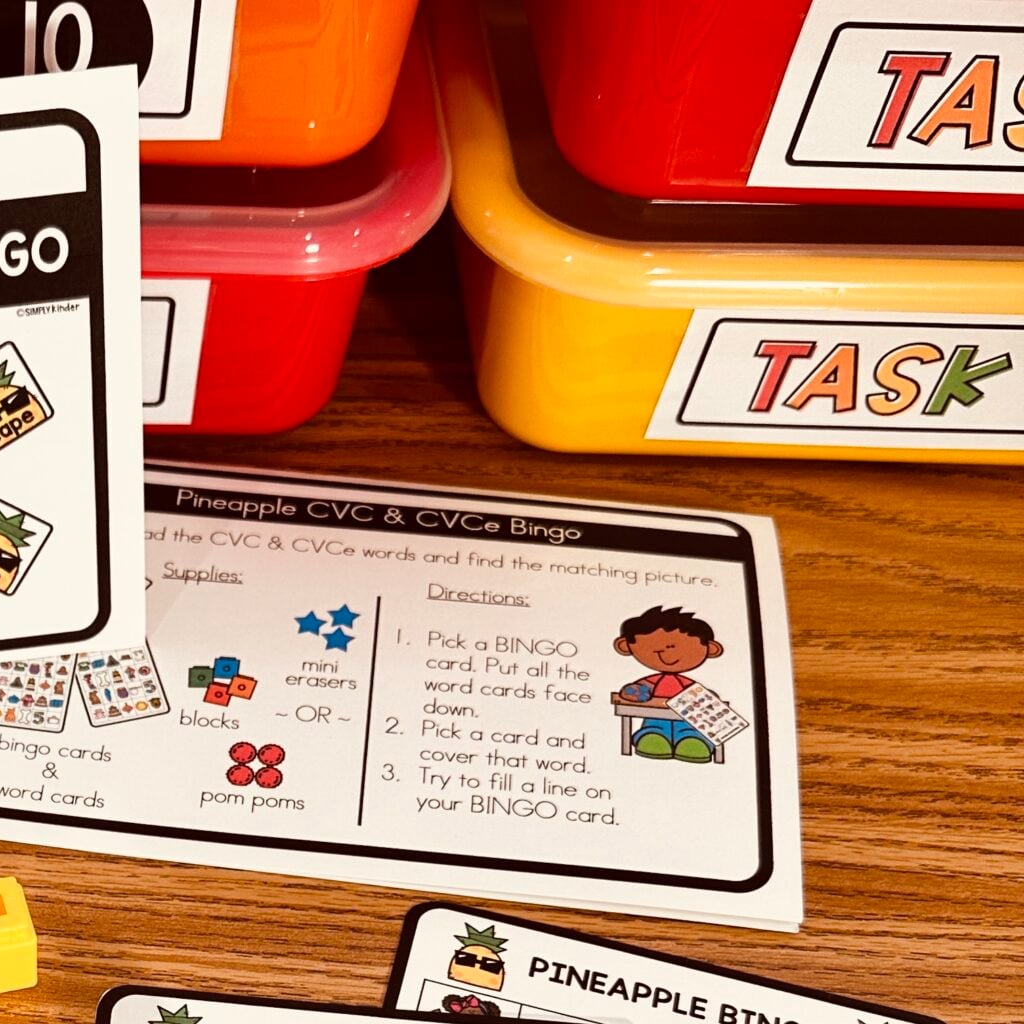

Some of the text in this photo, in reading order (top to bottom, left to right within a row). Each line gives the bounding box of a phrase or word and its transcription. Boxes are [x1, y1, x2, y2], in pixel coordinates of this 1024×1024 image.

[867, 51, 1024, 152] TA
[747, 340, 1013, 417] TASK
[176, 488, 581, 544] Pineapple CVC & CVCe Bingo
[144, 527, 719, 588] ad the CVC & CVCe words and find the matching picture.
[162, 562, 243, 586] Supplies:
[427, 583, 531, 607] Directions:
[397, 629, 578, 658] 1. Pick a BINGO
[302, 660, 339, 673] mini
[426, 656, 590, 681] card. Put all the
[286, 674, 357, 690] erasers
[425, 679, 591, 704] word cards face
[179, 709, 240, 730] blocks
[295, 704, 332, 723] OR
[423, 698, 479, 718] down.
[385, 716, 585, 749] 2. Pick a card and
[58, 745, 112, 762] cards
[420, 749, 591, 774] cover that word.
[41, 761, 59, 780] &
[381, 764, 611, 800] 3. Try to fill a line on
[51, 790, 105, 808] cards
[200, 791, 305, 813] pom poms
[416, 795, 620, 826] your BINGO card.
[528, 956, 709, 1021] PINEAPPLE
